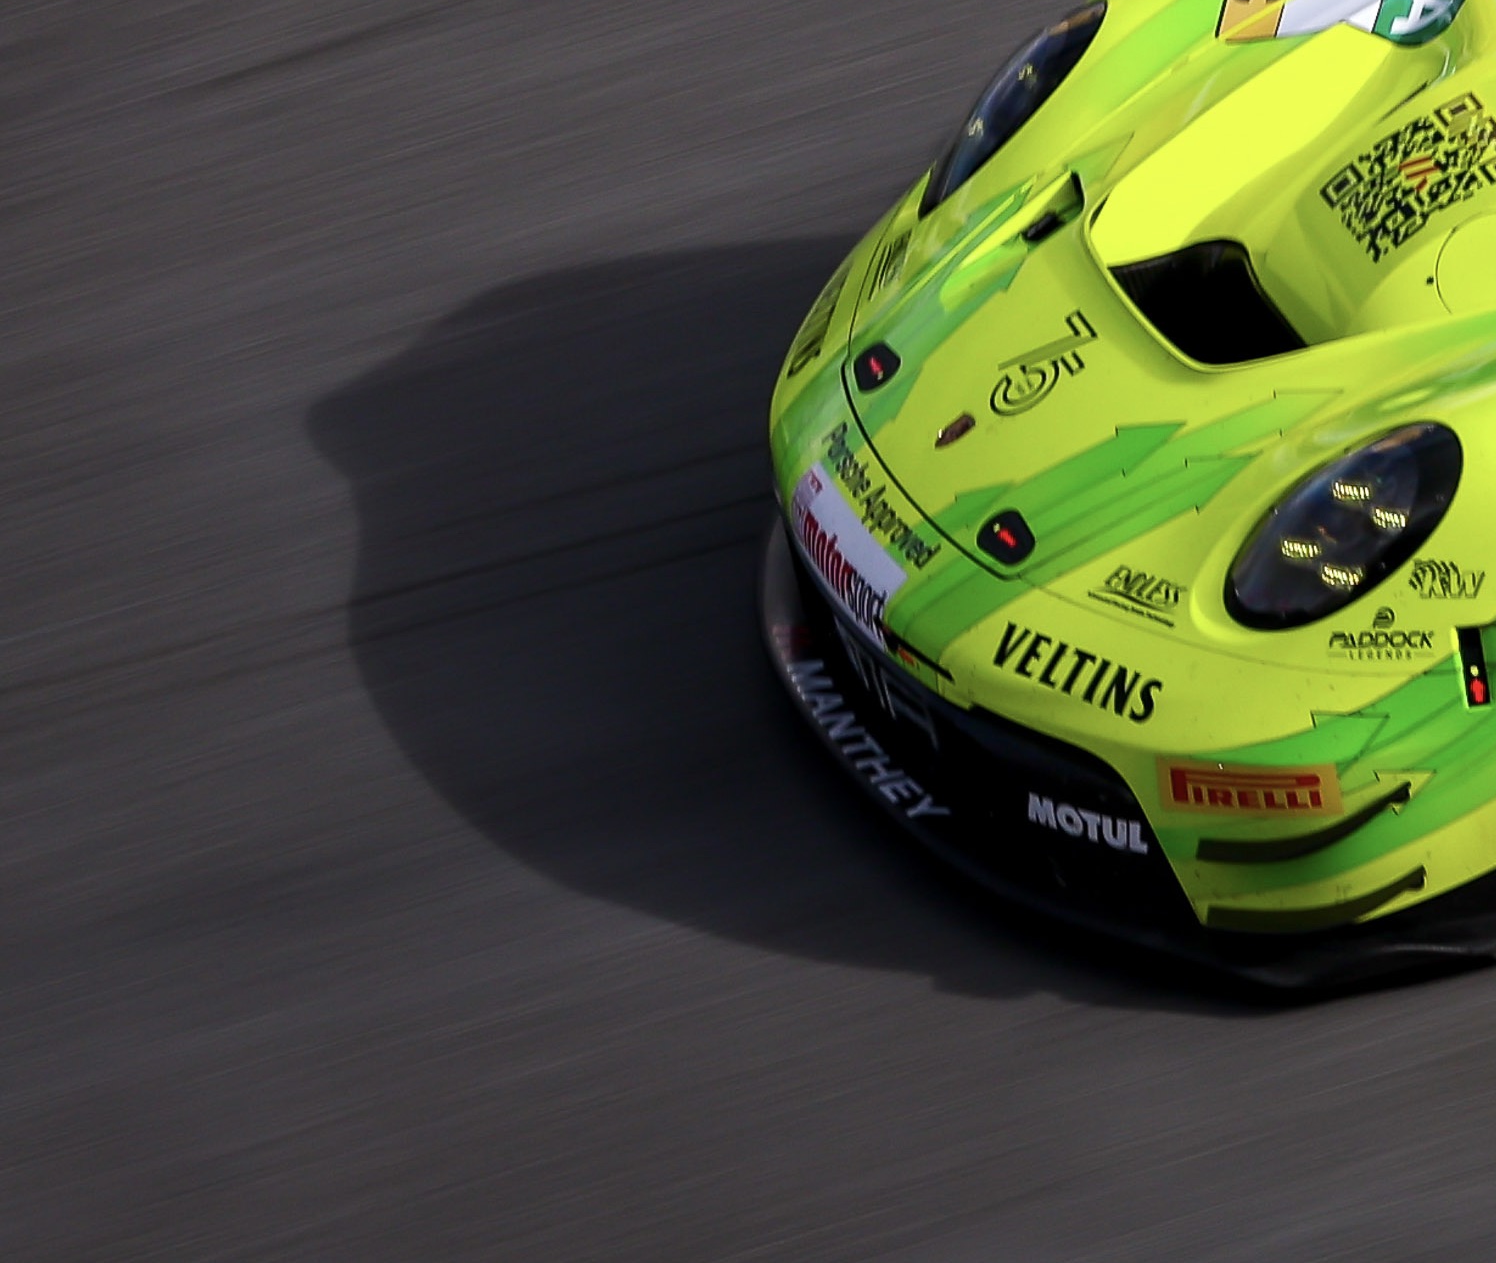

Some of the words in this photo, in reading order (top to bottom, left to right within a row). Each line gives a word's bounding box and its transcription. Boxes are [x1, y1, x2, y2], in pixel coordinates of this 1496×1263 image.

[1328, 629, 1435, 649] PADDOCK
[992, 620, 1162, 724] VELTINS
[786, 658, 951, 819] MANTHEY
[1169, 766, 1323, 809] PIRELLI
[1028, 791, 1148, 855] MOTUL
